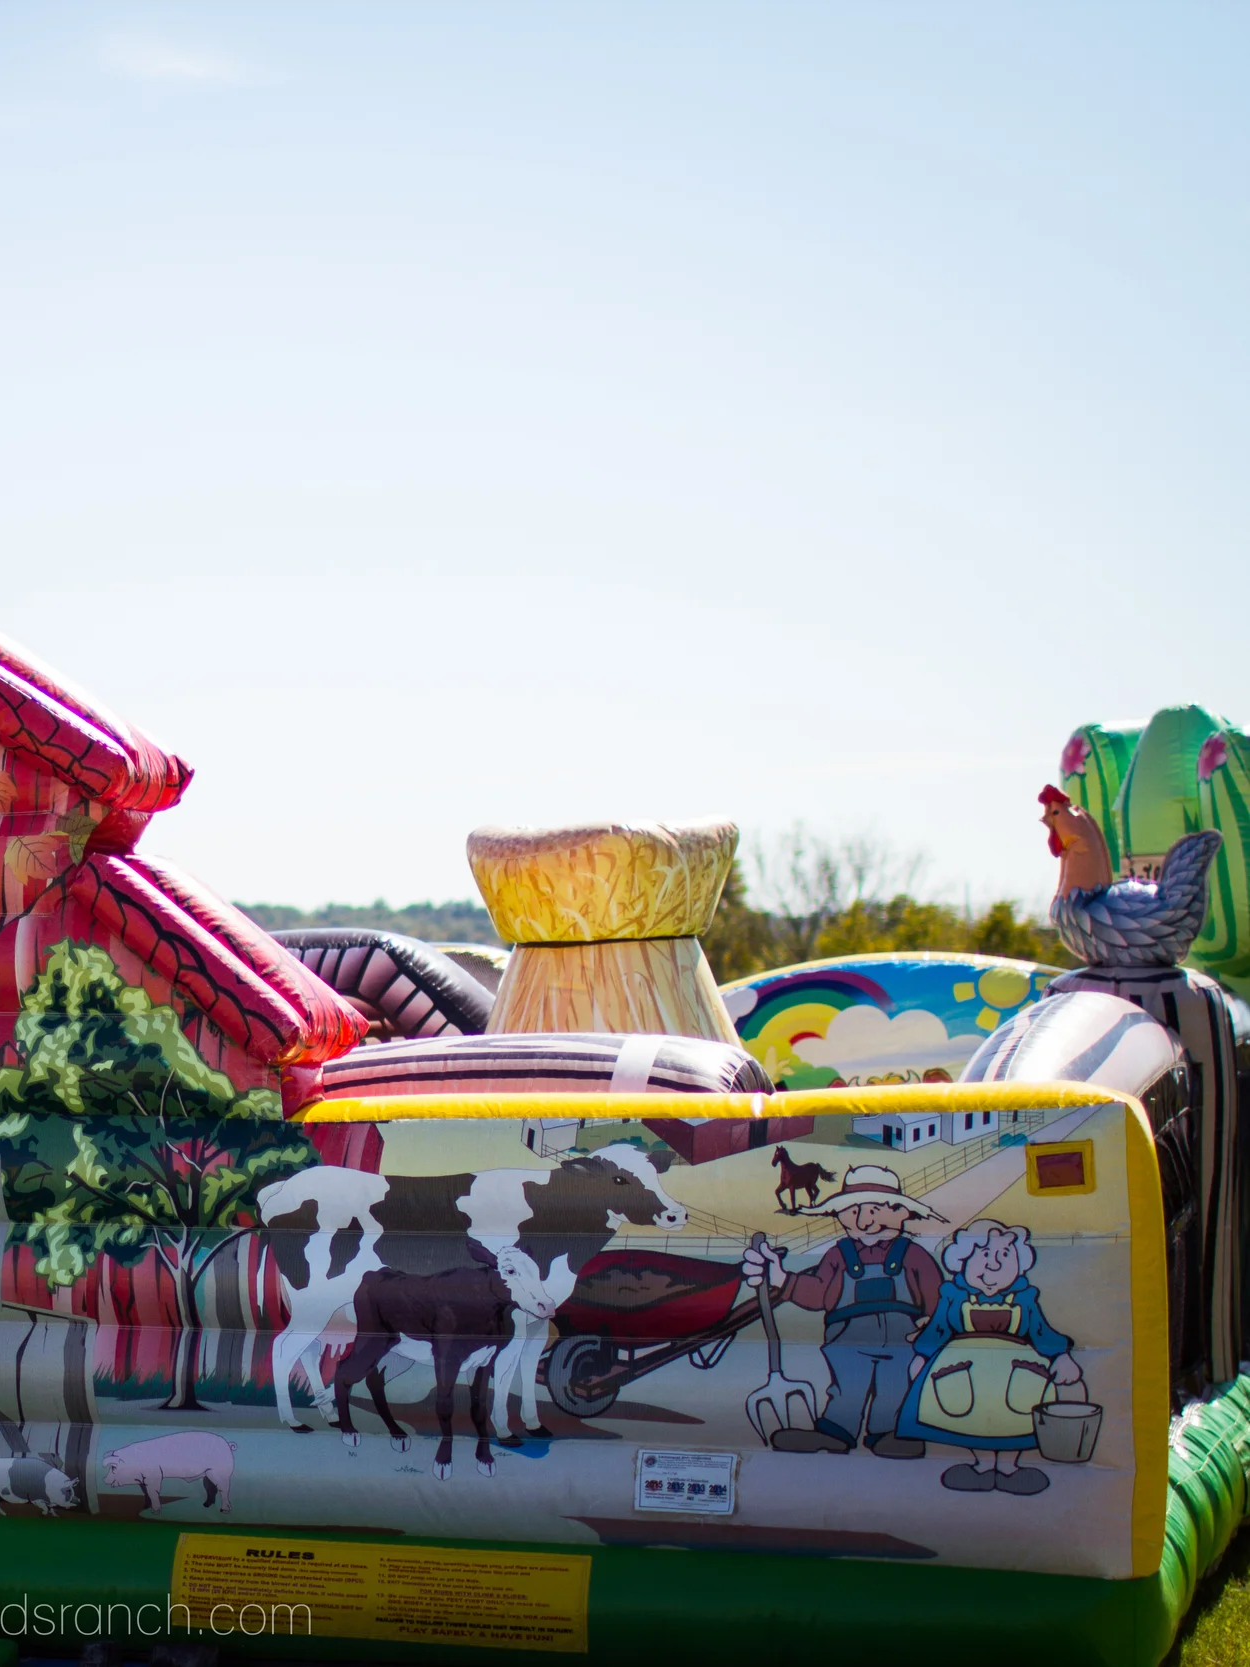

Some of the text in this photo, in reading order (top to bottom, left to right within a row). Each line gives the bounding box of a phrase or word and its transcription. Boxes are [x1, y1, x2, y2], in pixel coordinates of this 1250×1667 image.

[246, 1549, 315, 1560] RULES
[399, 1626, 427, 1634] PLAY
[431, 1628, 474, 1637] SAFELY
[491, 1632, 522, 1640] HAVE
[526, 1634, 554, 1642] FUN!
